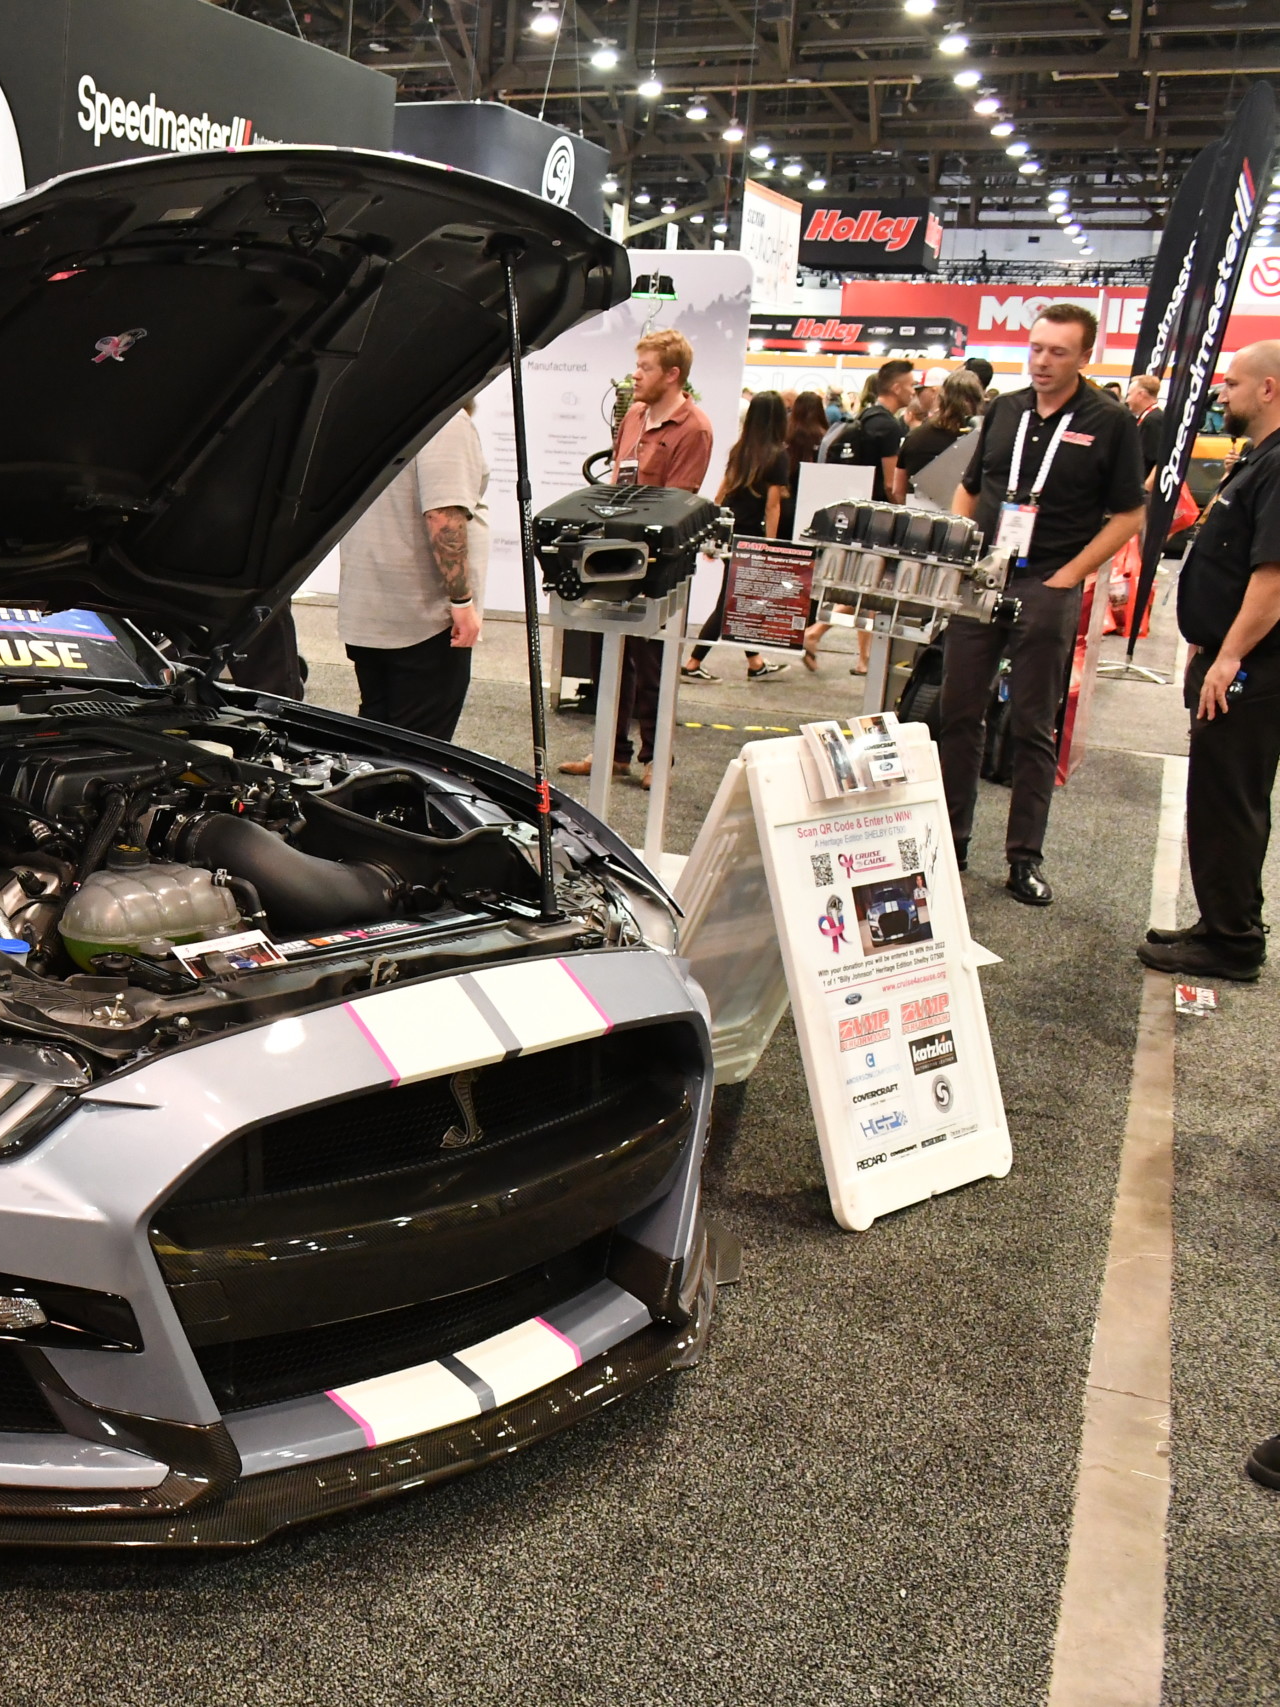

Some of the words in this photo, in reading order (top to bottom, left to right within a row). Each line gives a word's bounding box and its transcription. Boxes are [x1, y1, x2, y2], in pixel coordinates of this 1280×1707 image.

[78, 75, 231, 152] Speedmaster
[804, 209, 919, 252] Holley
[793, 318, 863, 345] Holley
[528, 361, 588, 373] Manufactured.
[1160, 210, 1248, 502] Speedmaster
[797, 826, 818, 838] Scan
[820, 824, 832, 835] QR
[834, 820, 854, 832] Code
[856, 819, 862, 828] &
[864, 816, 884, 827] Enter
[885, 814, 893, 824] to
[894, 810, 913, 821] WIN!
[820, 836, 843, 848] Heritage
[844, 833, 863, 844] Edition
[865, 828, 887, 839] SHELBY
[888, 825, 906, 836] GT500
[855, 850, 881, 860] CRUISE
[818, 969, 829, 977] With
[831, 967, 841, 976] your
[843, 962, 864, 972] donation
[865, 960, 873, 968] you
[891, 951, 908, 960] entered
[915, 946, 924, 955] WIN
[925, 944, 934, 952] this
[876, 964, 895, 974] Heritage
[896, 960, 913, 969] Edition
[913, 956, 929, 965] Shelby
[930, 952, 944, 961] GT500
[916, 993, 950, 1018] VMP
[853, 1009, 890, 1035] VMP
[912, 1039, 953, 1062] katzkin
[852, 1083, 898, 1104] COVERCRAFT
[856, 1152, 887, 1171] RECARO
